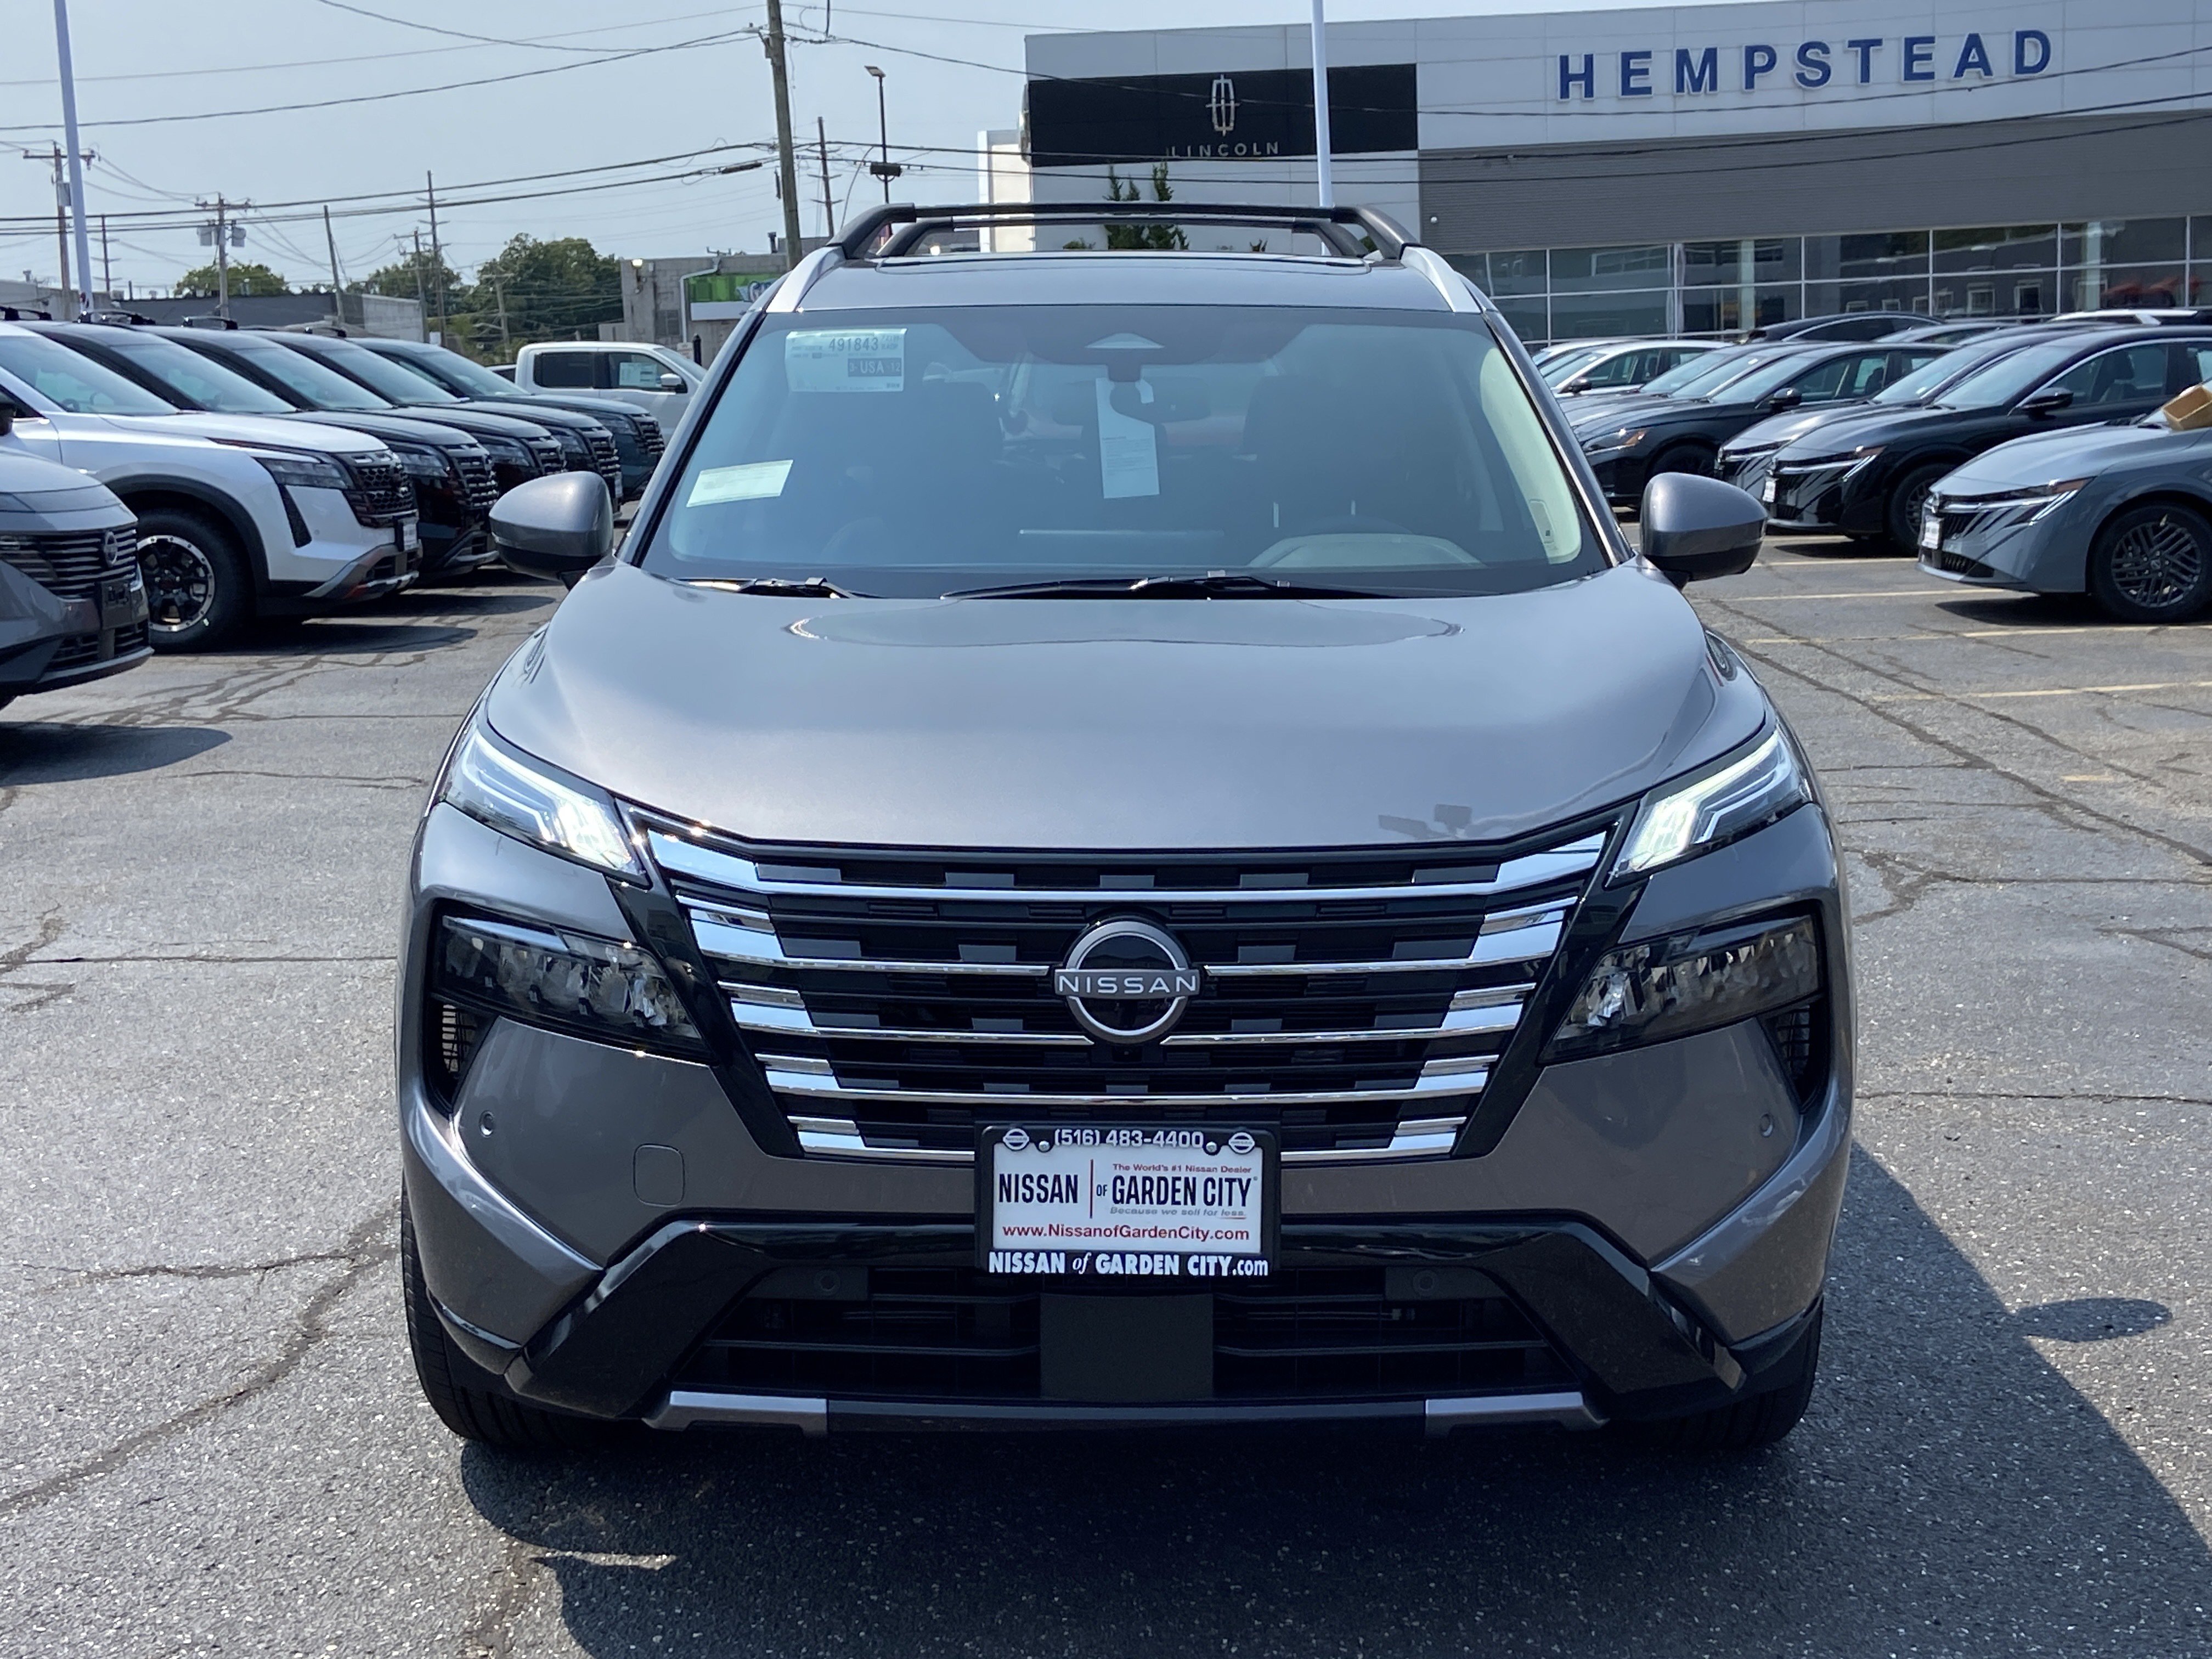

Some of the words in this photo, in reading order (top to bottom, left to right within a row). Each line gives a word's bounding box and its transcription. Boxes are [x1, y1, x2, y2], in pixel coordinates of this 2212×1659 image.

[1558, 29, 2052, 100] HEMPSTEAD
[1171, 141, 1278, 157] LINCOLN
[828, 337, 879, 352] 491843
[860, 359, 885, 374] USA
[1058, 975, 1196, 994] NISSAN
[1054, 1128, 1101, 1147] (516)
[1105, 1129, 1205, 1149] 483-4400
[1112, 1163, 1130, 1171] The
[1133, 1164, 1169, 1172] World's
[1171, 1164, 1182, 1172] #1
[1185, 1165, 1218, 1173] Nissan
[1220, 1165, 1252, 1173] Dealer
[998, 1173, 1079, 1204] NISSAN
[1096, 1184, 1108, 1197] OF
[1112, 1175, 1197, 1206] GARDEN
[1203, 1177, 1252, 1207] CITY
[1110, 1206, 1158, 1215] Because
[1002, 1223, 1250, 1242] www.NissanofGardenCity.com
[989, 1251, 1066, 1273] NISSAN
[1073, 1251, 1092, 1275] of
[1095, 1253, 1180, 1276] GARDEN
[1187, 1255, 1269, 1277] CITY.com
